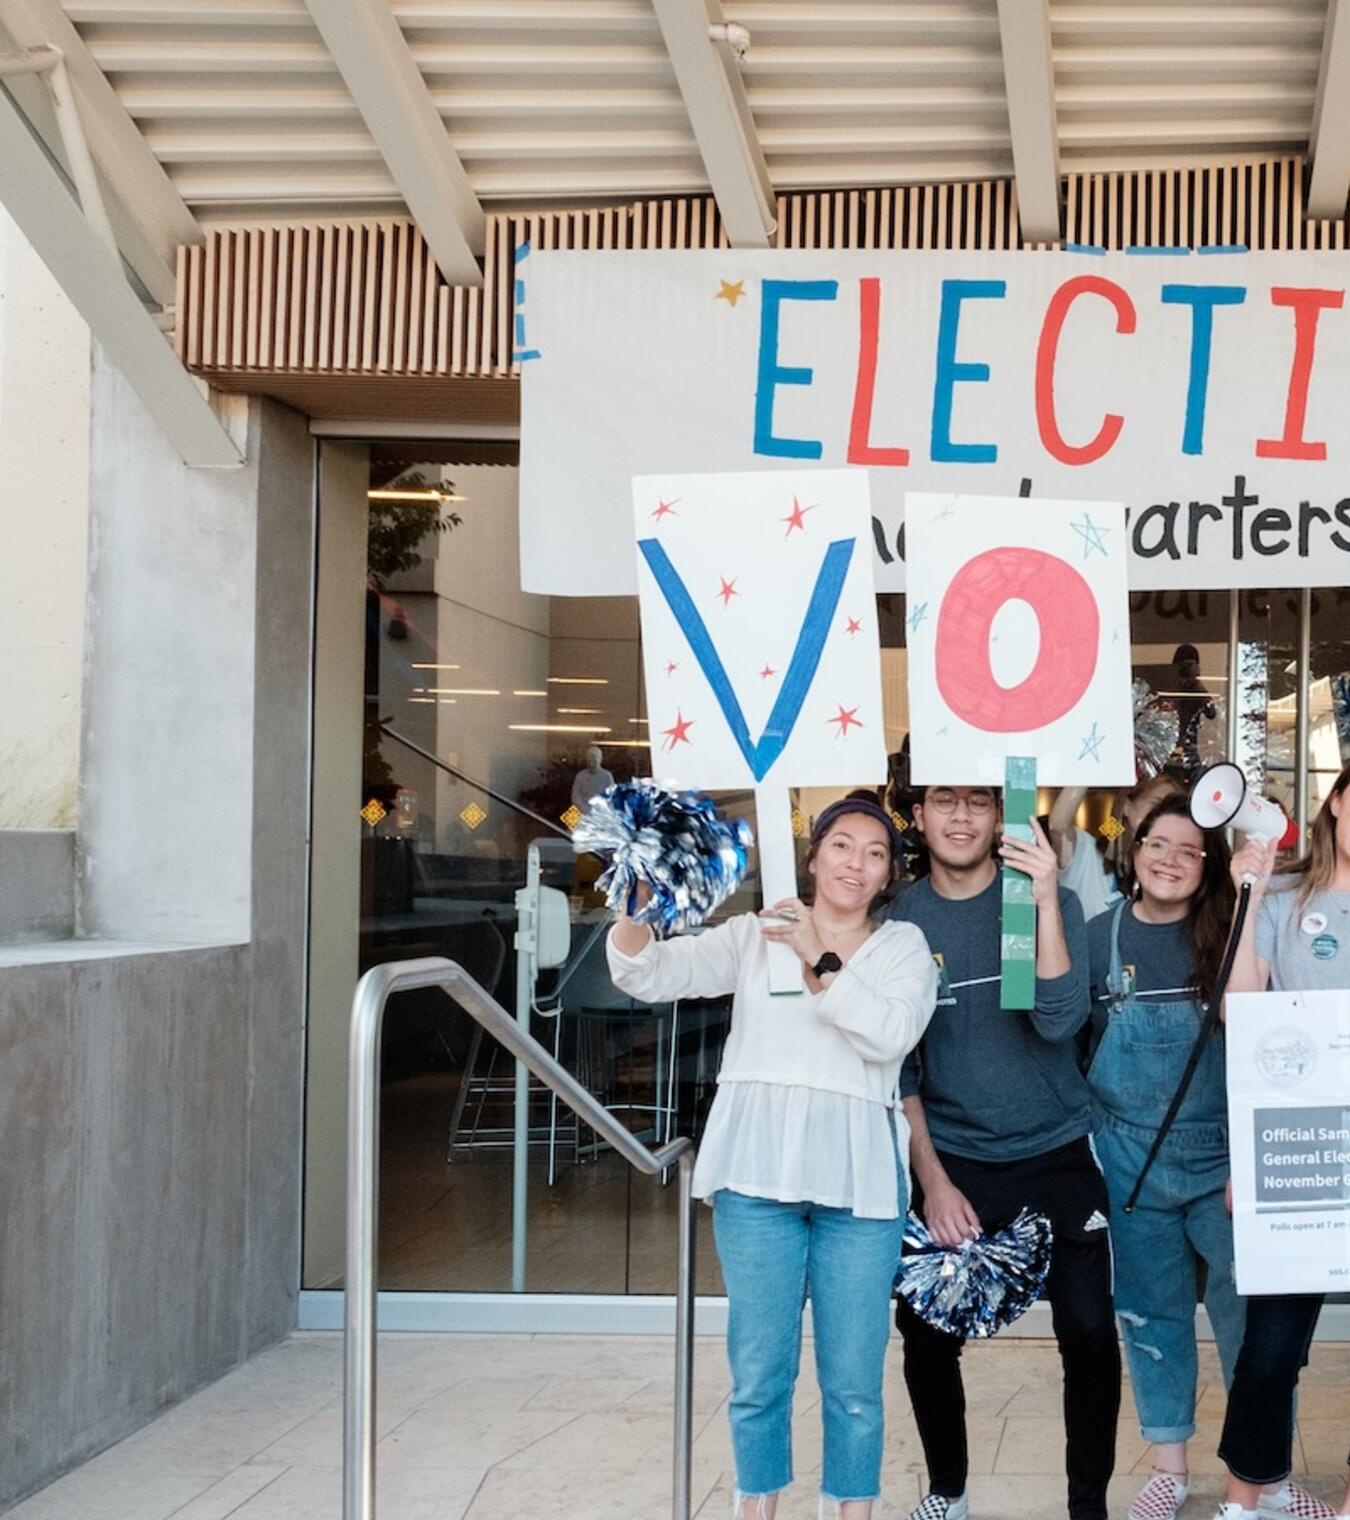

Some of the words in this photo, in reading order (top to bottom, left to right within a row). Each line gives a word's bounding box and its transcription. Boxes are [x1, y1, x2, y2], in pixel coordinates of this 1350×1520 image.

[937, 548, 1099, 732] O
[638, 538, 855, 783] V
[1262, 1127, 1315, 1142] Official
[1263, 1151, 1320, 1166] General
[1263, 1174, 1340, 1189] November
[1270, 1222, 1291, 1231] Polls
[1293, 1222, 1315, 1232] open
[1316, 1221, 1325, 1229] at
